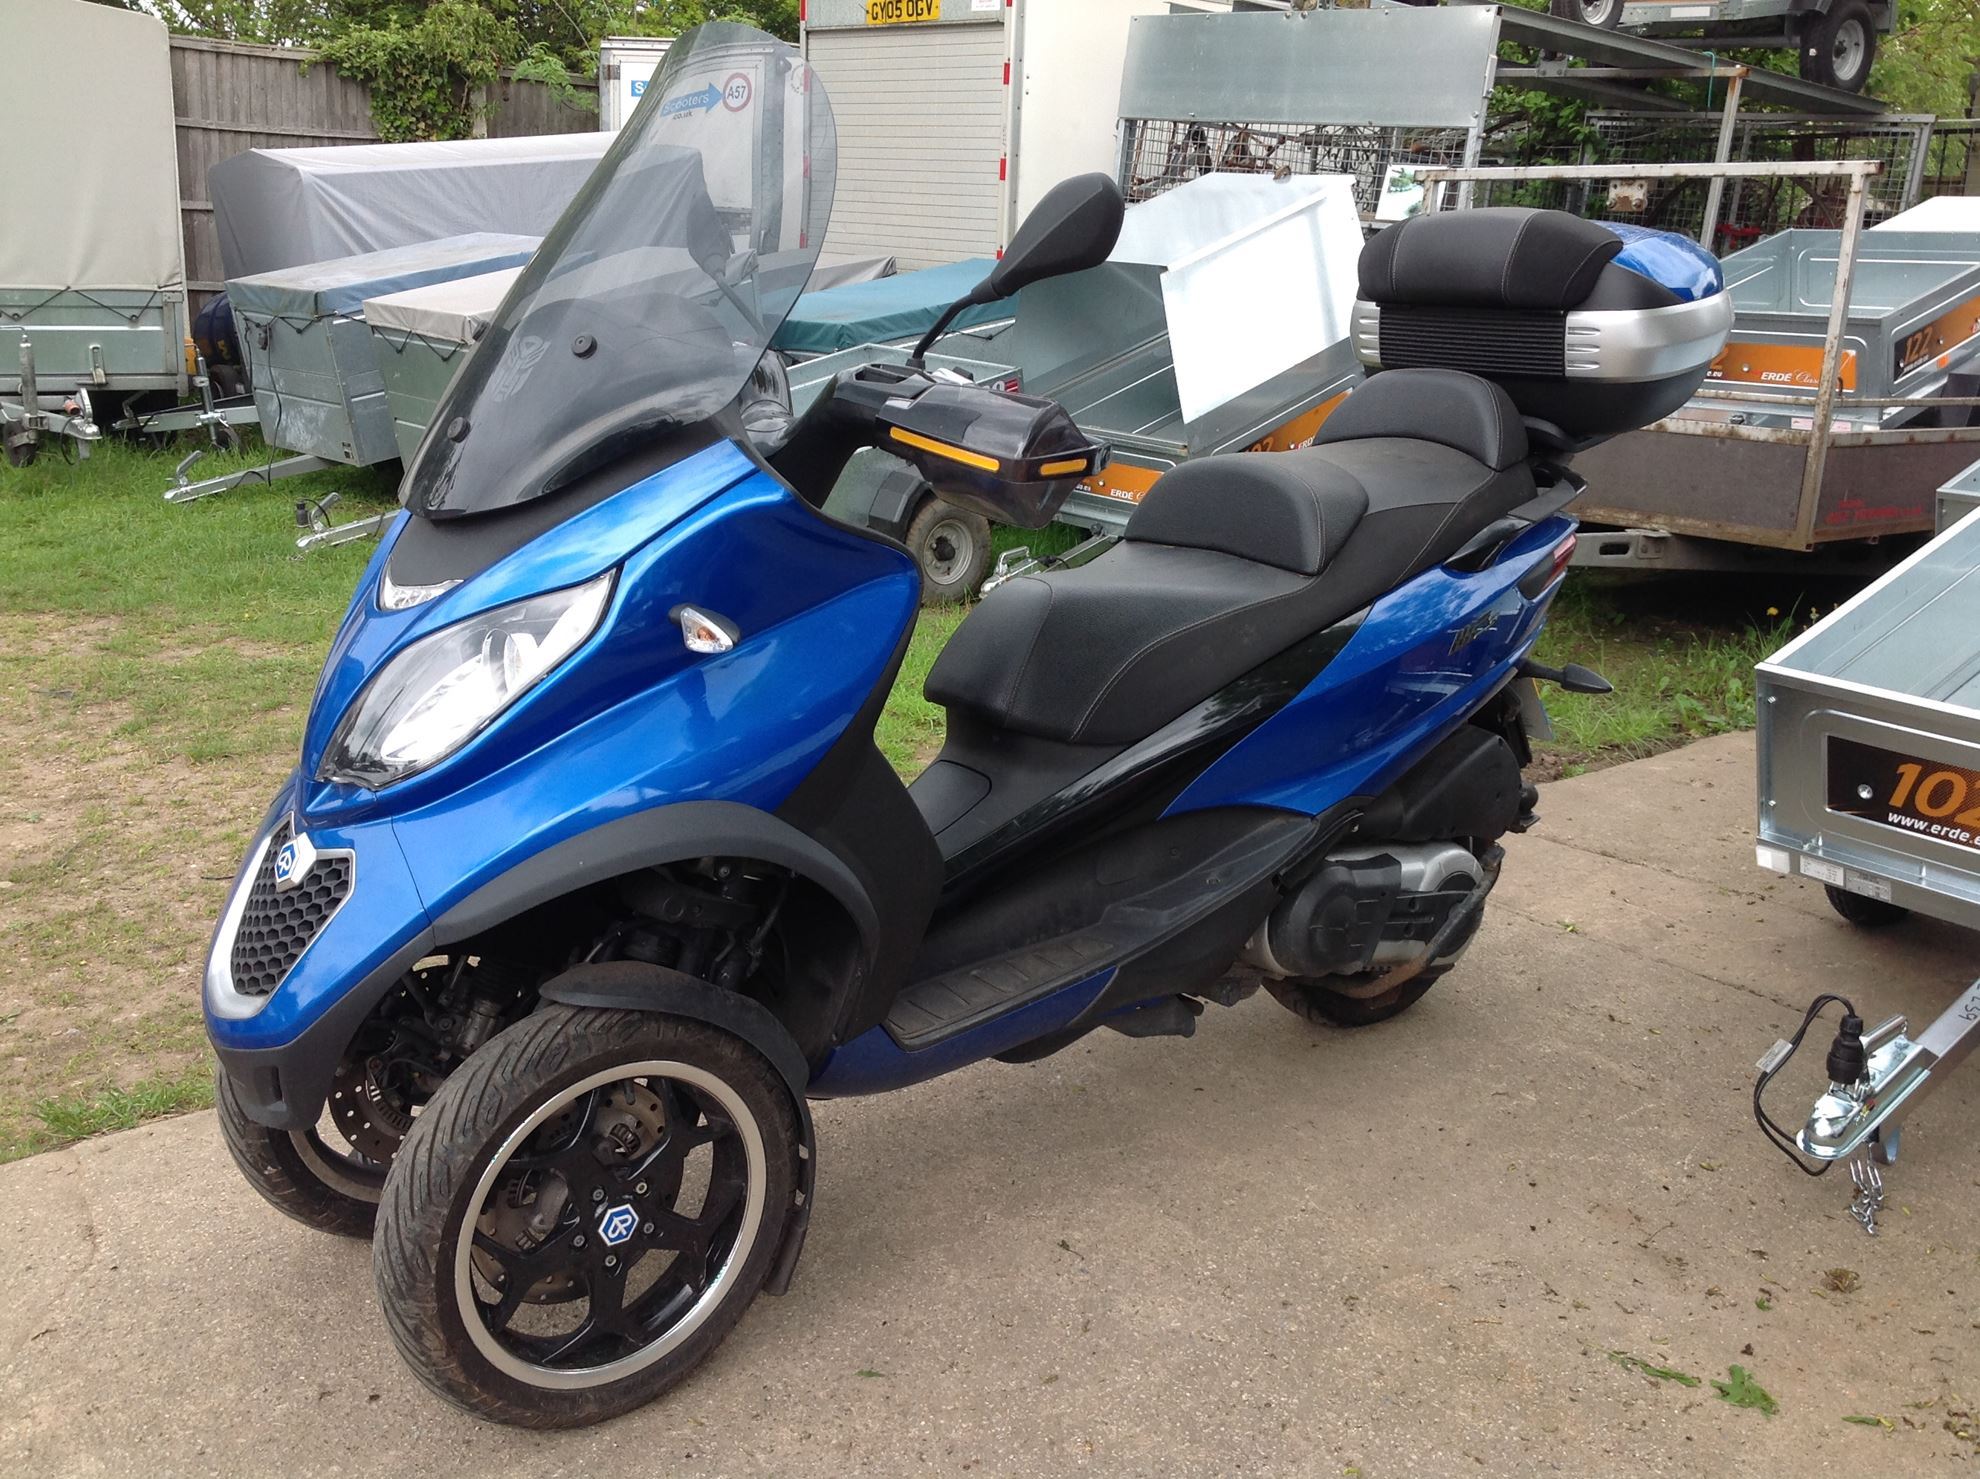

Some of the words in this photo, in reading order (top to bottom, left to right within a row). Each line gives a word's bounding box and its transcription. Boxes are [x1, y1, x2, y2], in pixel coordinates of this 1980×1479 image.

[871, 0, 903, 20] GY05
[906, 0, 933, 17] OGV
[726, 85, 746, 99] A57
[663, 93, 710, 115] Scooters
[1904, 325, 1933, 365] 122
